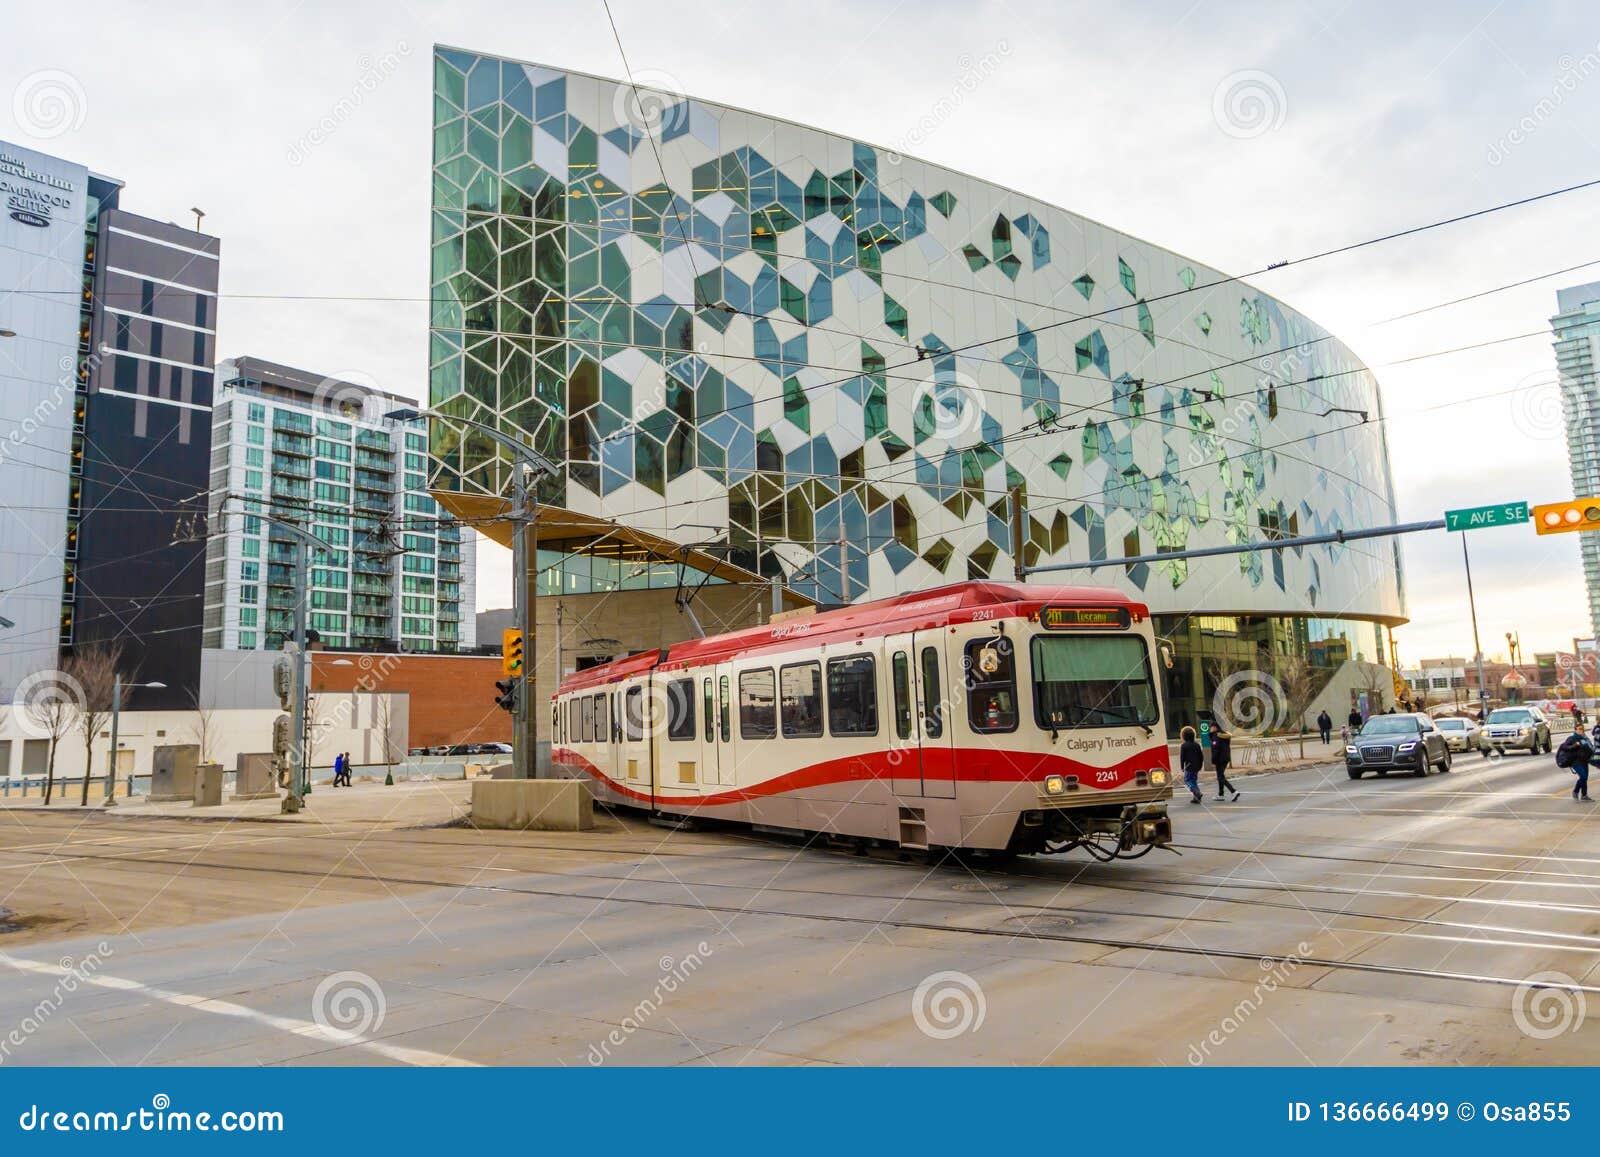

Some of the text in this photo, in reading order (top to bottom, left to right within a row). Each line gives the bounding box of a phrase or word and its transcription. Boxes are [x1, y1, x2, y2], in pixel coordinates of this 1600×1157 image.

[48, 174, 73, 192] Inn
[8, 196, 51, 215] SUITES
[1450, 506, 1525, 527] 7 AVE SE
[971, 610, 994, 621] 2241
[1067, 736, 1136, 752] Calgary Transit
[1096, 771, 1118, 782] 2241
